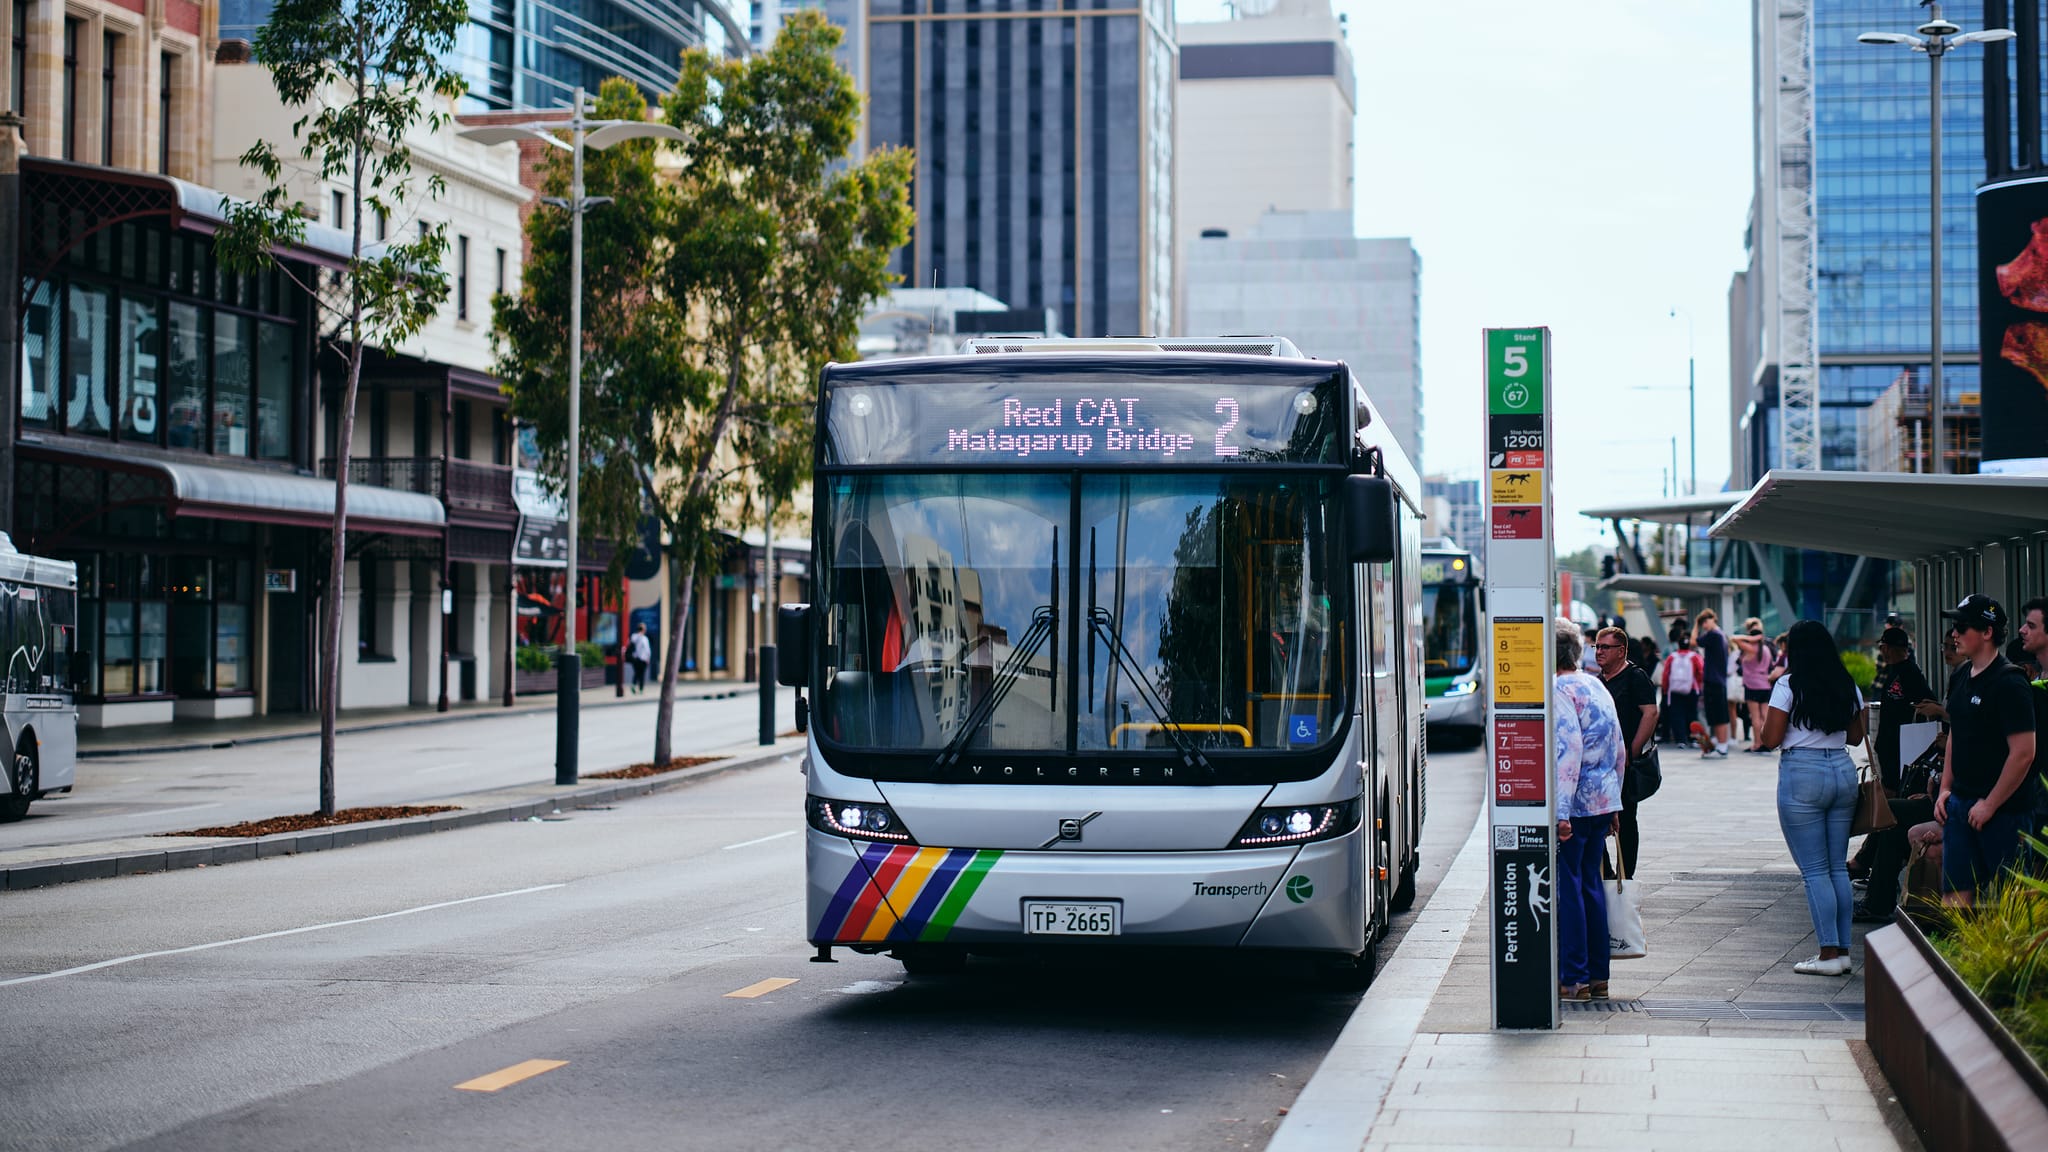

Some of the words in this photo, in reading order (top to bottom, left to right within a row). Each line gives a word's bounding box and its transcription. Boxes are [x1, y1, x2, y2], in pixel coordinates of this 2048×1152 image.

[1513, 333, 1537, 342] Stand
[133, 302, 157, 434] CITY
[1503, 346, 1529, 378] 5
[1508, 391, 1524, 402] 67
[1004, 398, 1062, 427] Red
[1075, 398, 1140, 427] CAT
[1215, 397, 1240, 456] 2
[948, 428, 1093, 456] Matagarup
[1106, 428, 1195, 456] Bridge
[1503, 435, 1543, 448] 12901
[1500, 640, 1508, 651] 8
[1498, 662, 1511, 673] 10
[1498, 685, 1511, 696] 10
[1500, 736, 1508, 747] 7
[972, 765, 1174, 777] VOLGREN
[1498, 759, 1511, 771] 10
[1498, 783, 1512, 794] 10
[1519, 826, 1537, 834] Live
[1519, 835, 1544, 844] Times
[1192, 881, 1267, 899] Transperth
[1503, 862, 1518, 916] Station
[1504, 921, 1518, 963] Perth
